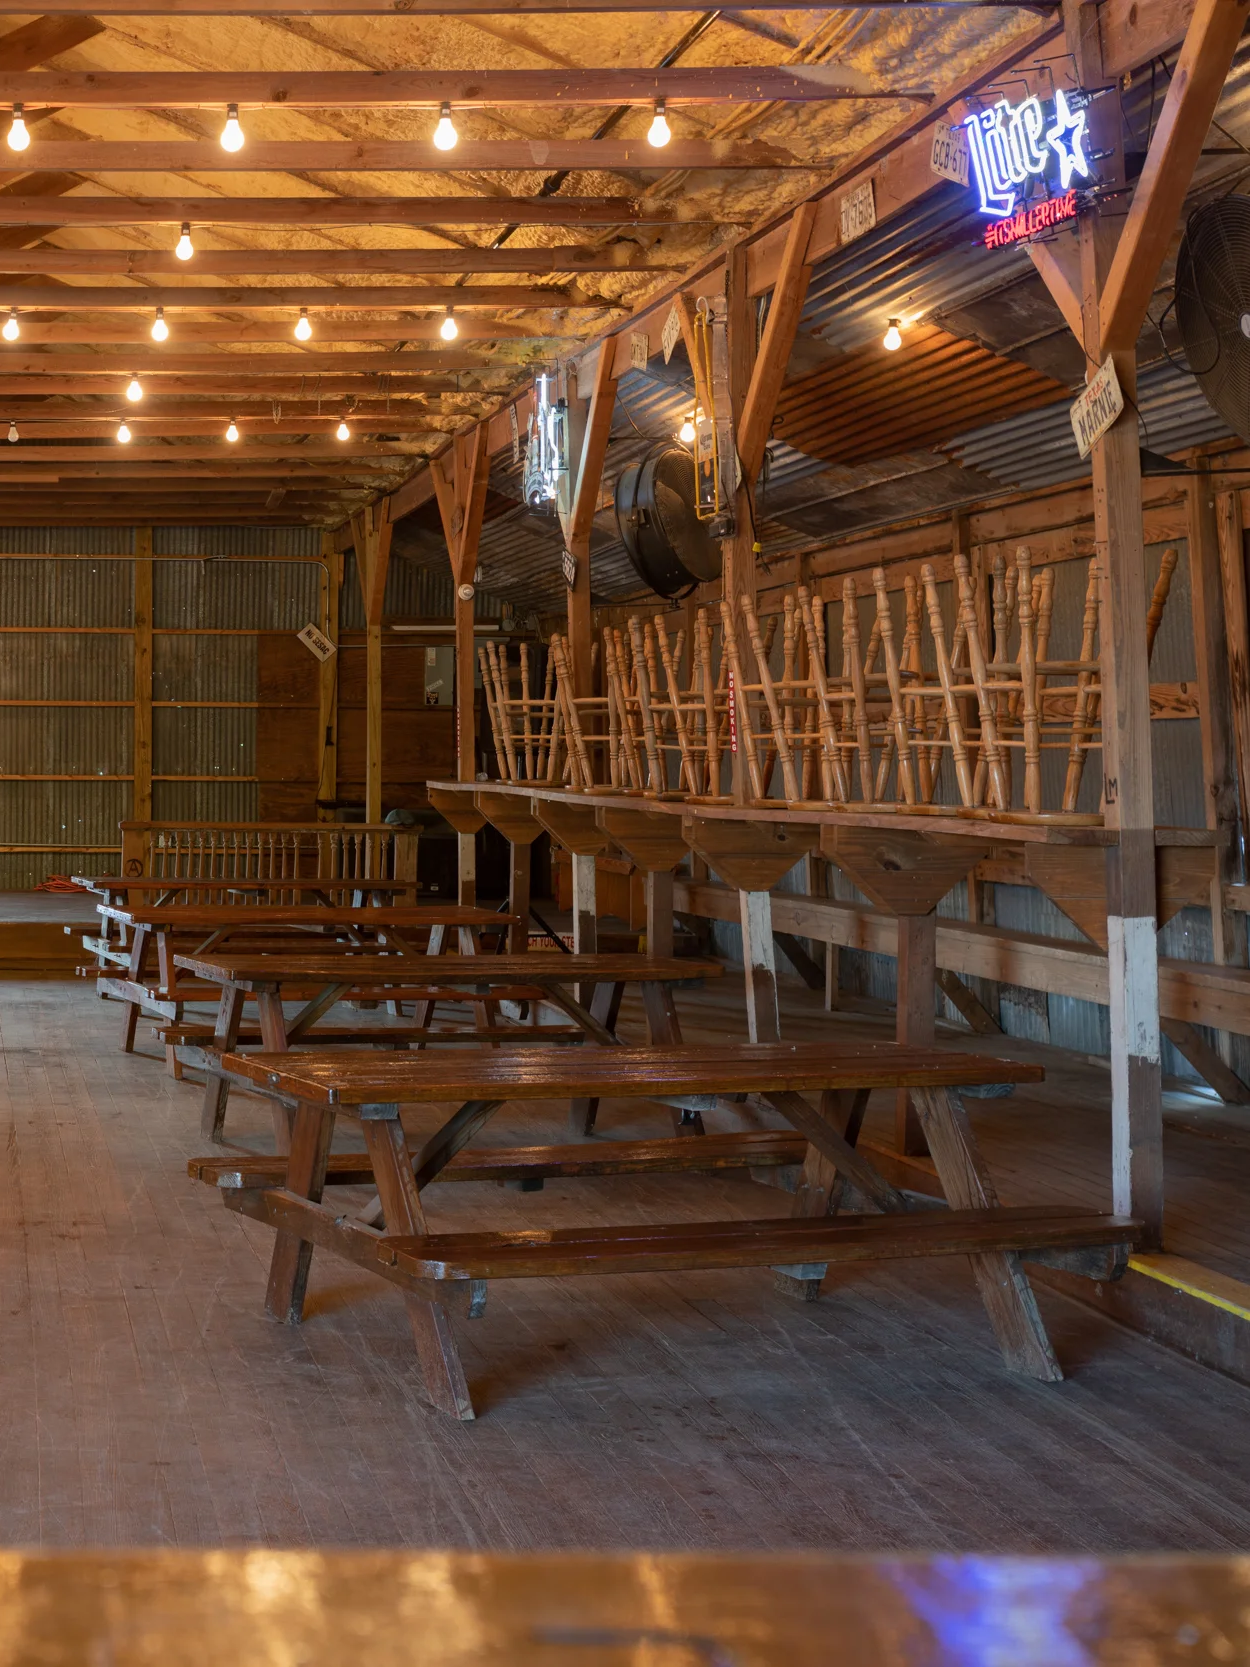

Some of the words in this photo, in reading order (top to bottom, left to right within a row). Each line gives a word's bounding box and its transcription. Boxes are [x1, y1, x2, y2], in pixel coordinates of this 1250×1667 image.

[963, 97, 1049, 217] Lite
[1078, 380, 1117, 446] MARNIE
[1084, 376, 1105, 407] TEXAS
[305, 628, 315, 640] NO
[312, 636, 330, 655] SESAC
[728, 671, 734, 688] NO
[729, 690, 737, 751] SMOKING
